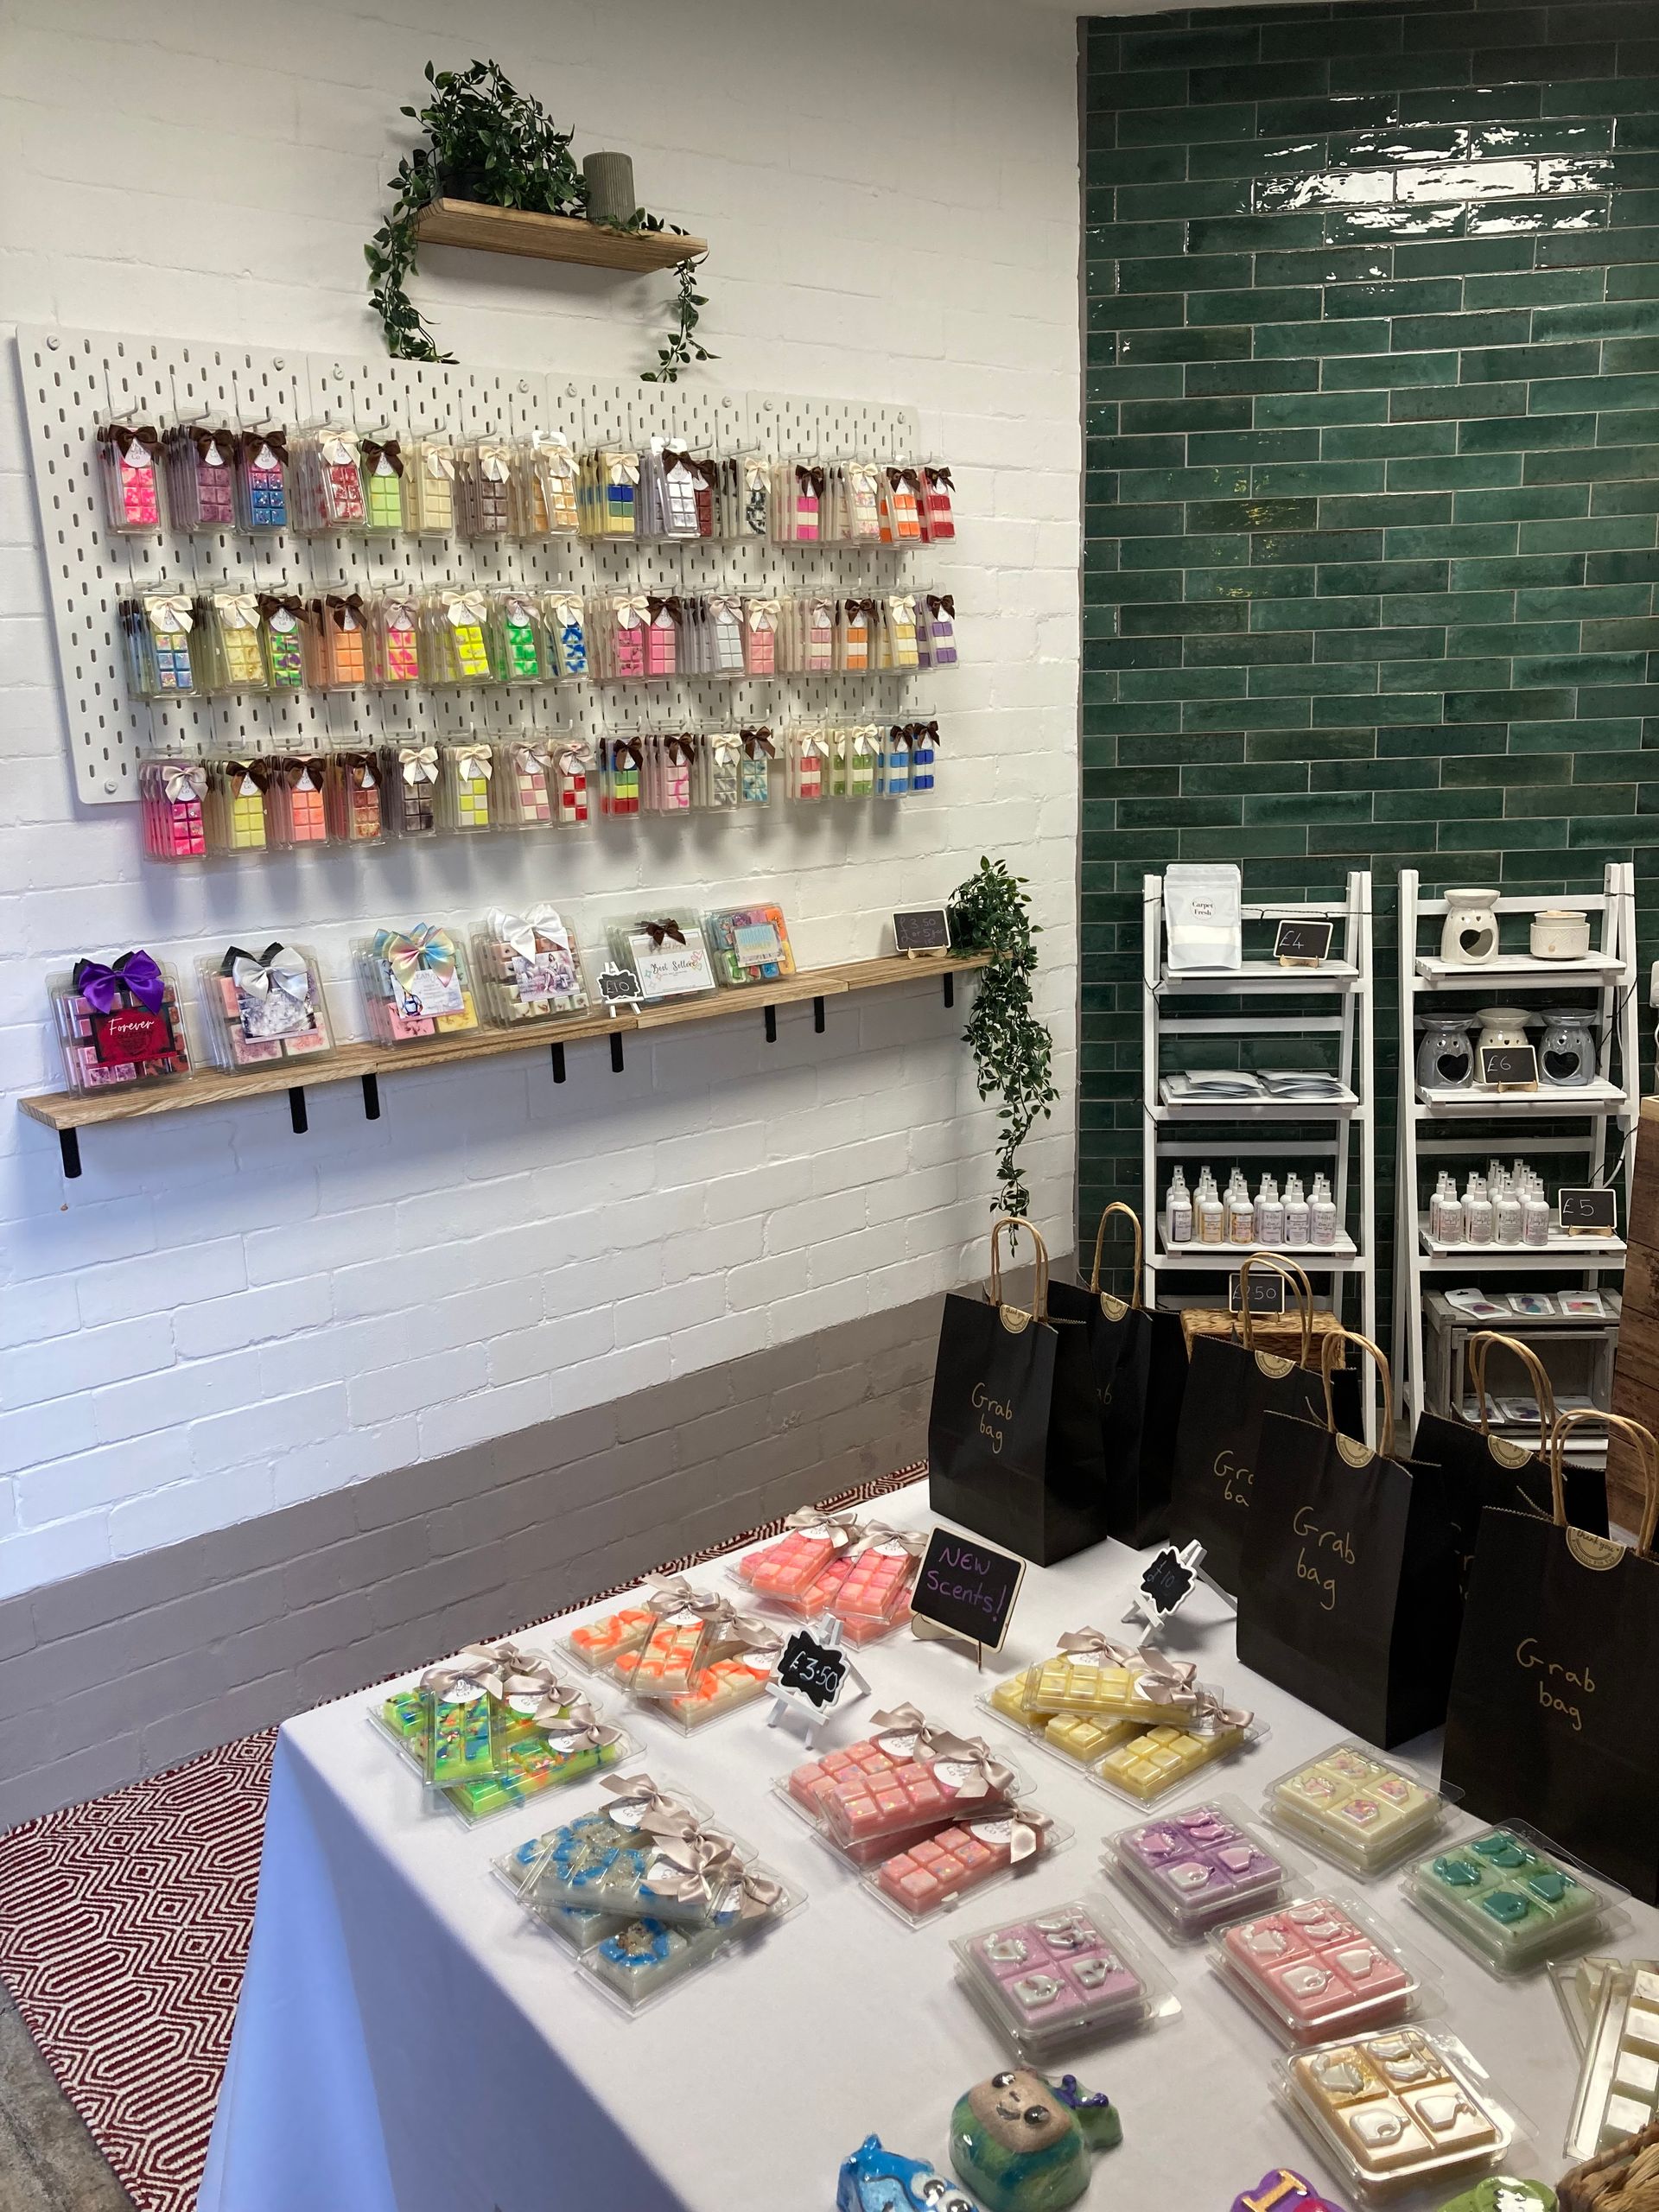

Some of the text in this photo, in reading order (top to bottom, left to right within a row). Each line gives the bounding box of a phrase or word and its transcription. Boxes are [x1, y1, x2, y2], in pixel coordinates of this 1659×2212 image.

[1192, 900, 1214, 910] Carpet
[1193, 908, 1212, 917] Fresh
[1279, 930, 1304, 950] £4
[650, 962, 668, 975] Best
[606, 979, 631, 995] £10
[107, 1017, 155, 1036] Forever
[1487, 1054, 1511, 1072] £6
[1562, 1198, 1595, 1217] £5
[971, 1382, 1014, 1421] Grab
[979, 1413, 1003, 1454] bag
[1213, 1450, 1254, 1485] Gr
[1224, 1478, 1250, 1508] ba
[1293, 1505, 1356, 1565] Grab
[938, 1546, 992, 1575] NEW
[1296, 1547, 1337, 1611] bag
[926, 1569, 1007, 1623] Scents!
[789, 1650, 838, 1694] £3.50
[1516, 1637, 1596, 1693] Grab
[1539, 1680, 1583, 1732] bag
